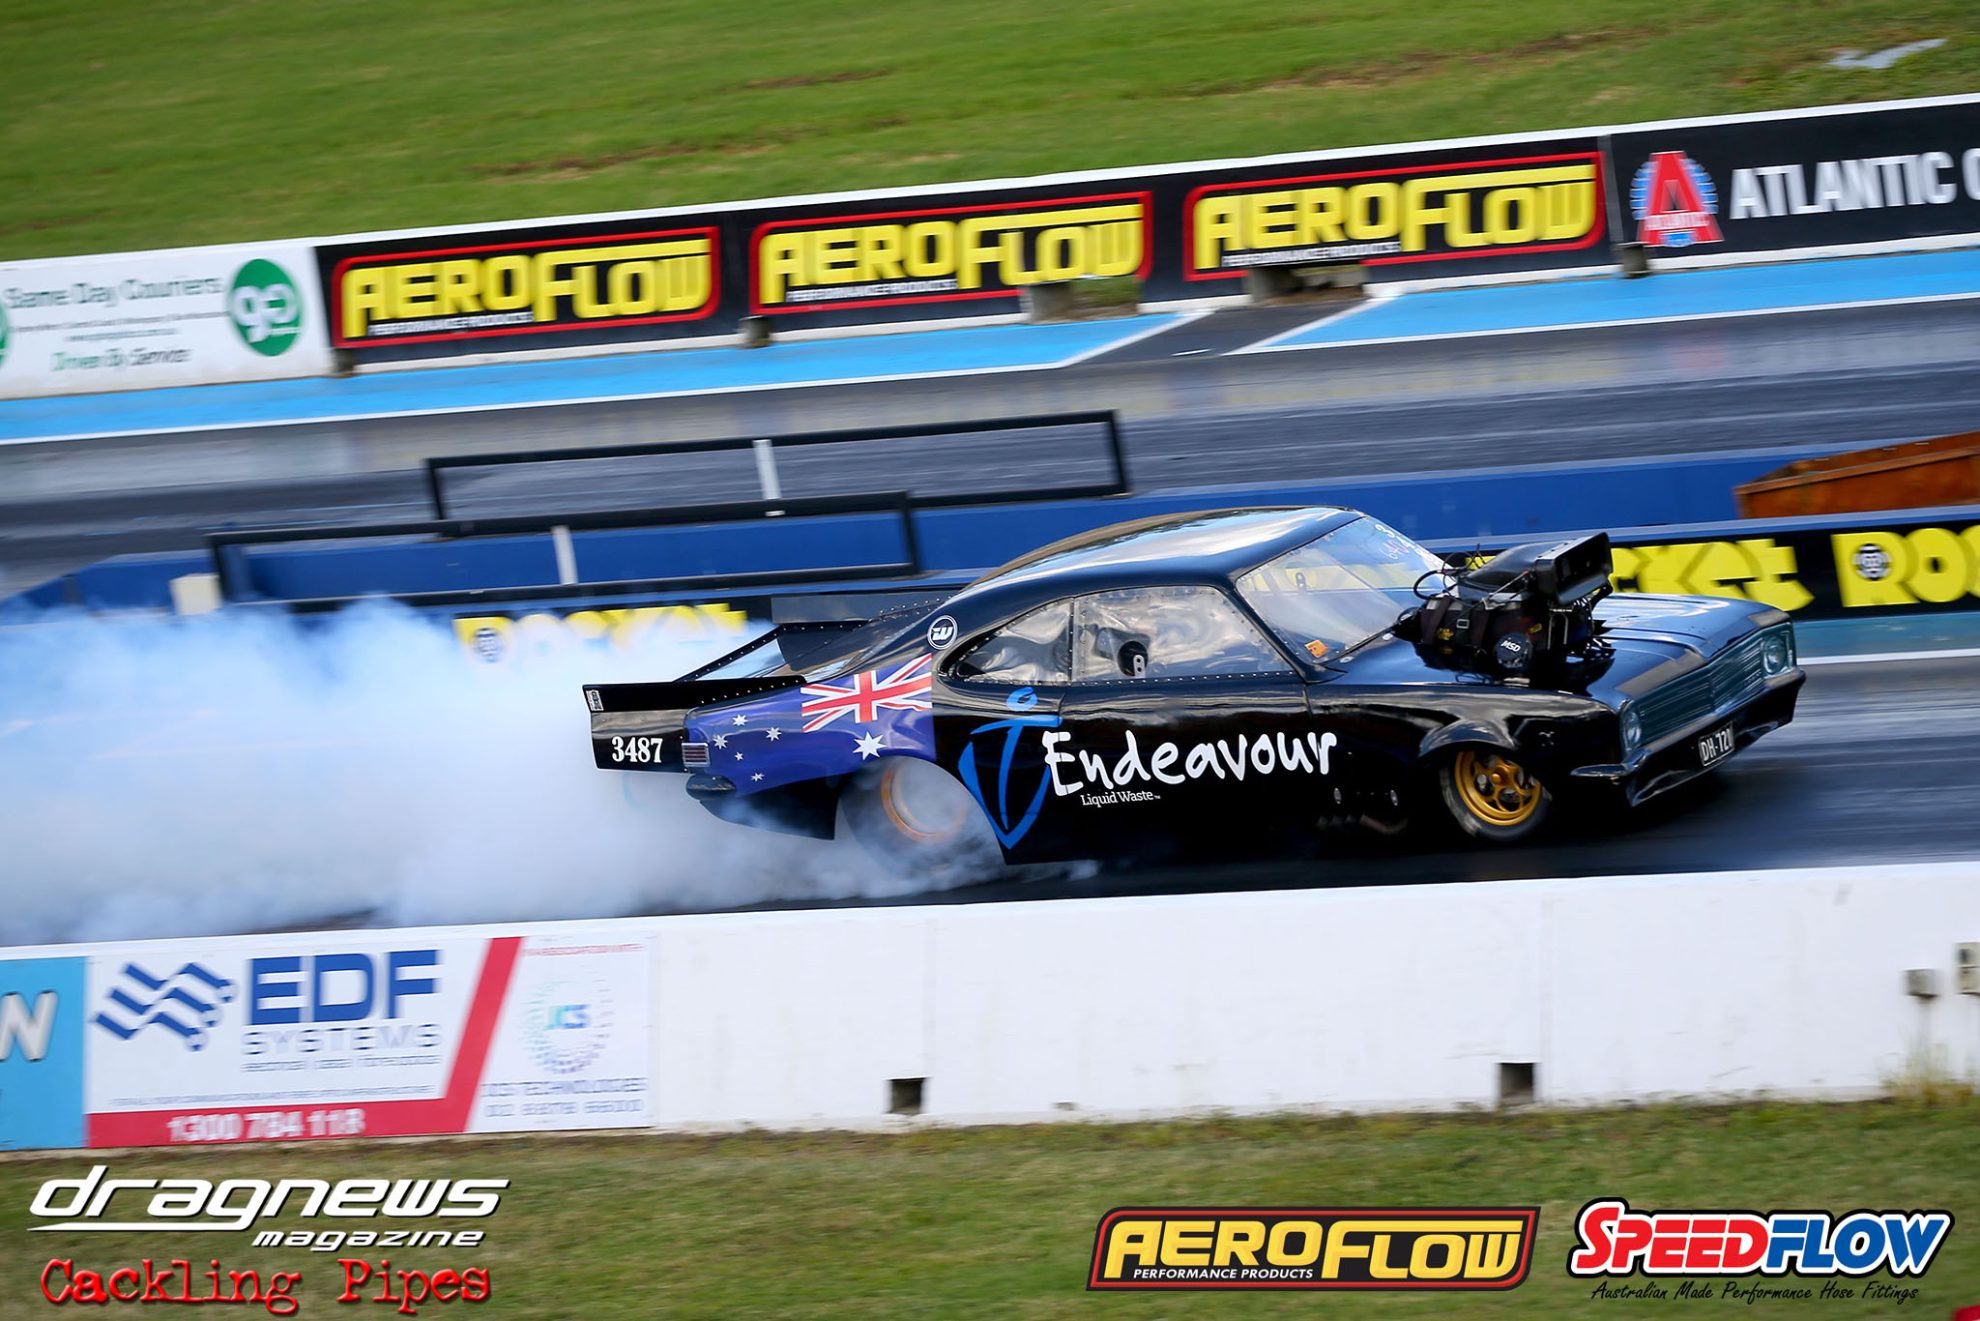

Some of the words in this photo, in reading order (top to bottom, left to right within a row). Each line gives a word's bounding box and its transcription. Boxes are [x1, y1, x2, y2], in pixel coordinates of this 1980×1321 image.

[1194, 165, 1597, 270] AEROFLOW
[1730, 151, 1957, 220] ATLANTIC
[342, 239, 711, 338] AEROFLOW
[760, 204, 1142, 305] AEROFLOW
[611, 735, 664, 763] 3487
[1042, 730, 1337, 796] Endeavour
[1081, 790, 1118, 807] Liquid
[249, 950, 442, 1025] EDF
[242, 1023, 442, 1056] SYSTEMS
